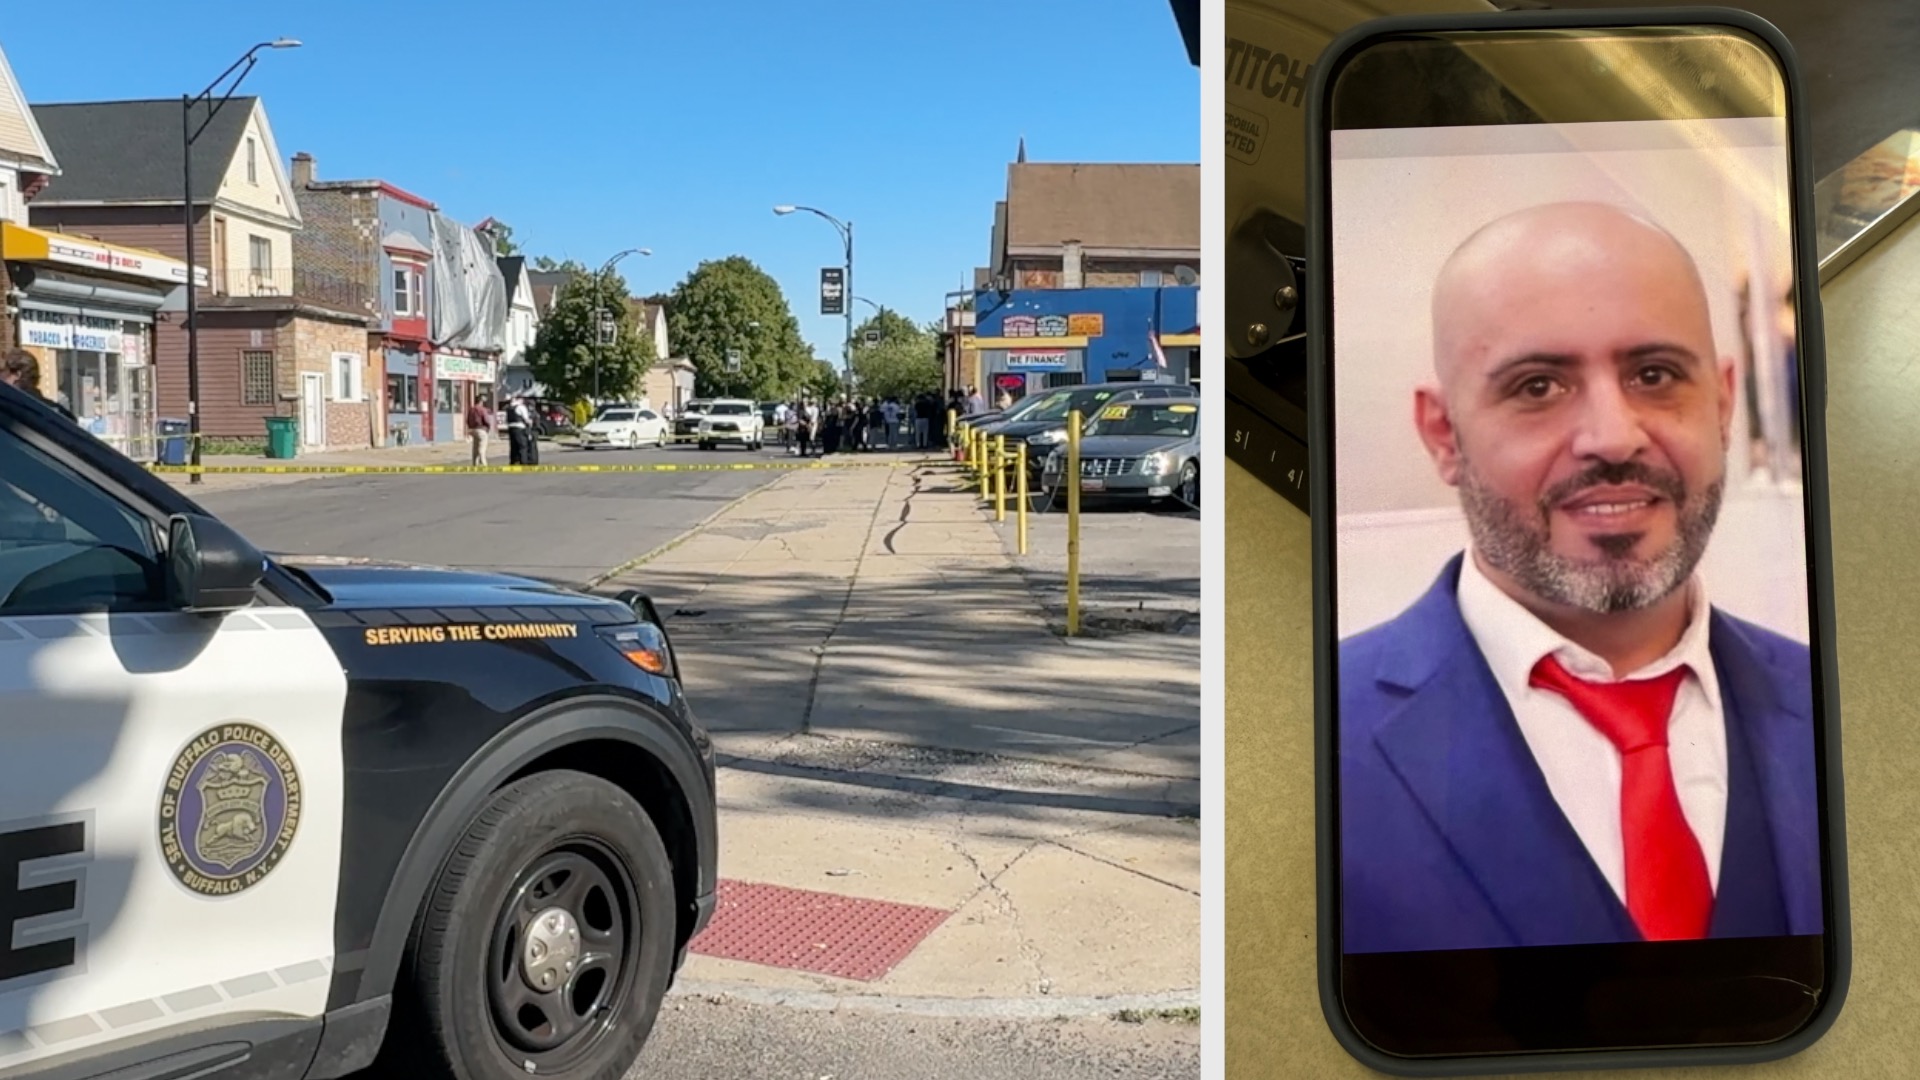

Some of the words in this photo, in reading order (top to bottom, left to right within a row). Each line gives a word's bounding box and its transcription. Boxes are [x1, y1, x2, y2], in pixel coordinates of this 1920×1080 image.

[1225, 36, 1314, 108] TITCH
[29, 330, 60, 345] TOBACCO
[1009, 355, 1022, 364] WE
[1024, 355, 1066, 364] FINANCE
[1234, 429, 1242, 443] 5
[1287, 468, 1296, 482] 4
[365, 626, 446, 645] SERVING
[447, 624, 482, 642] THE
[483, 623, 578, 640] COMMUNITY
[223, 725, 271, 749] POLICE
[168, 730, 220, 791] BUFFALO
[162, 794, 175, 818] OF
[268, 745, 299, 850] DEPARTMENT
[161, 823, 182, 864] SEAL
[183, 870, 243, 894] BUFFALO,
[246, 861, 273, 884] N.Y.
